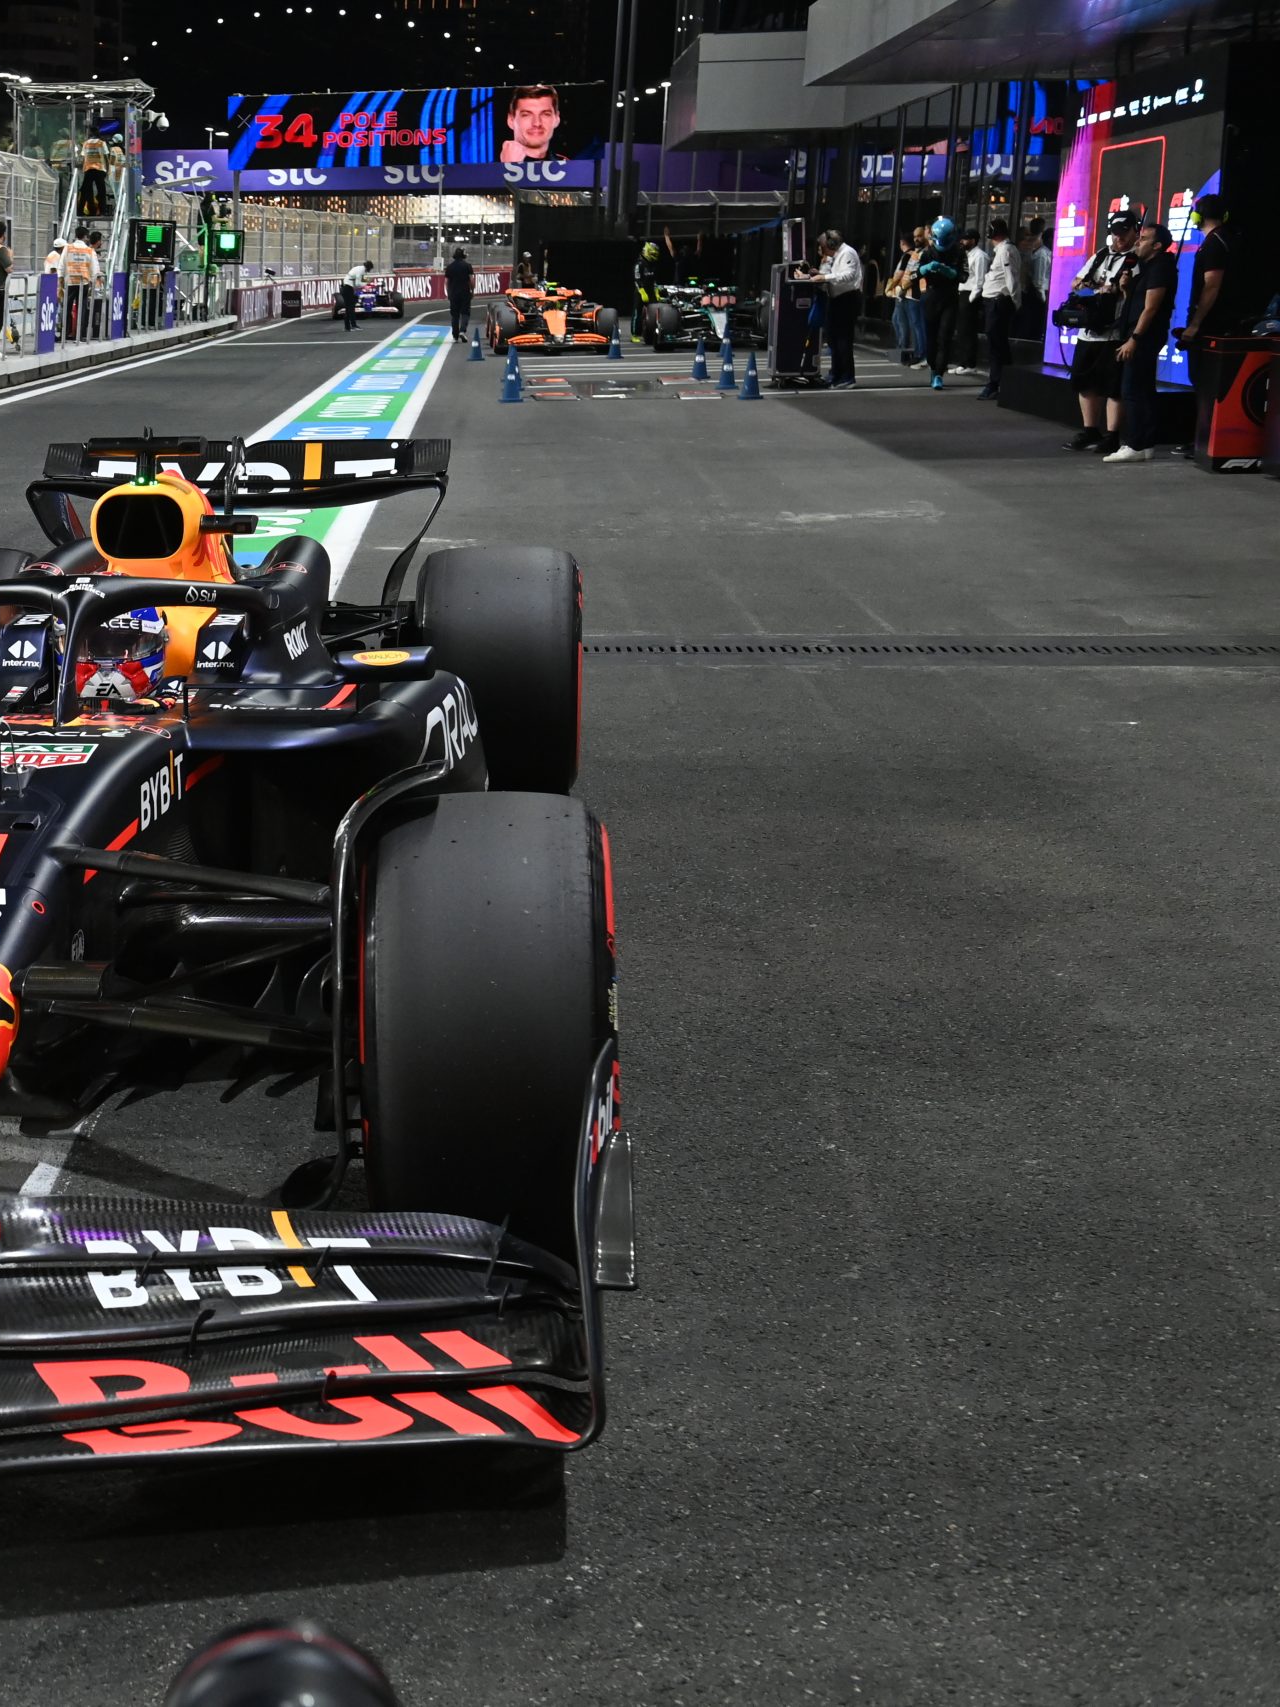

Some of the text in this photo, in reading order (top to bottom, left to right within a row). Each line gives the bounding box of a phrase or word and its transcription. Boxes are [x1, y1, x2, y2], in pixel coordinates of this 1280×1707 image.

[255, 113, 318, 148] 34
[340, 111, 398, 128] POLE
[323, 128, 447, 148] POSITIONS
[155, 155, 213, 186] stc
[503, 160, 567, 182] stc
[397, 276, 432, 299] AIRWAYS
[41, 296, 54, 331] stc
[199, 588, 217, 602] Sui
[283, 620, 310, 661] ROKT
[2, 659, 41, 668] inter.mx
[196, 660, 235, 668] inter.mx
[367, 652, 404, 660] RAUCH
[95, 683, 121, 697] EA
[141, 750, 184, 831] BYBIT
[85, 1211, 380, 1309] BYBIT
